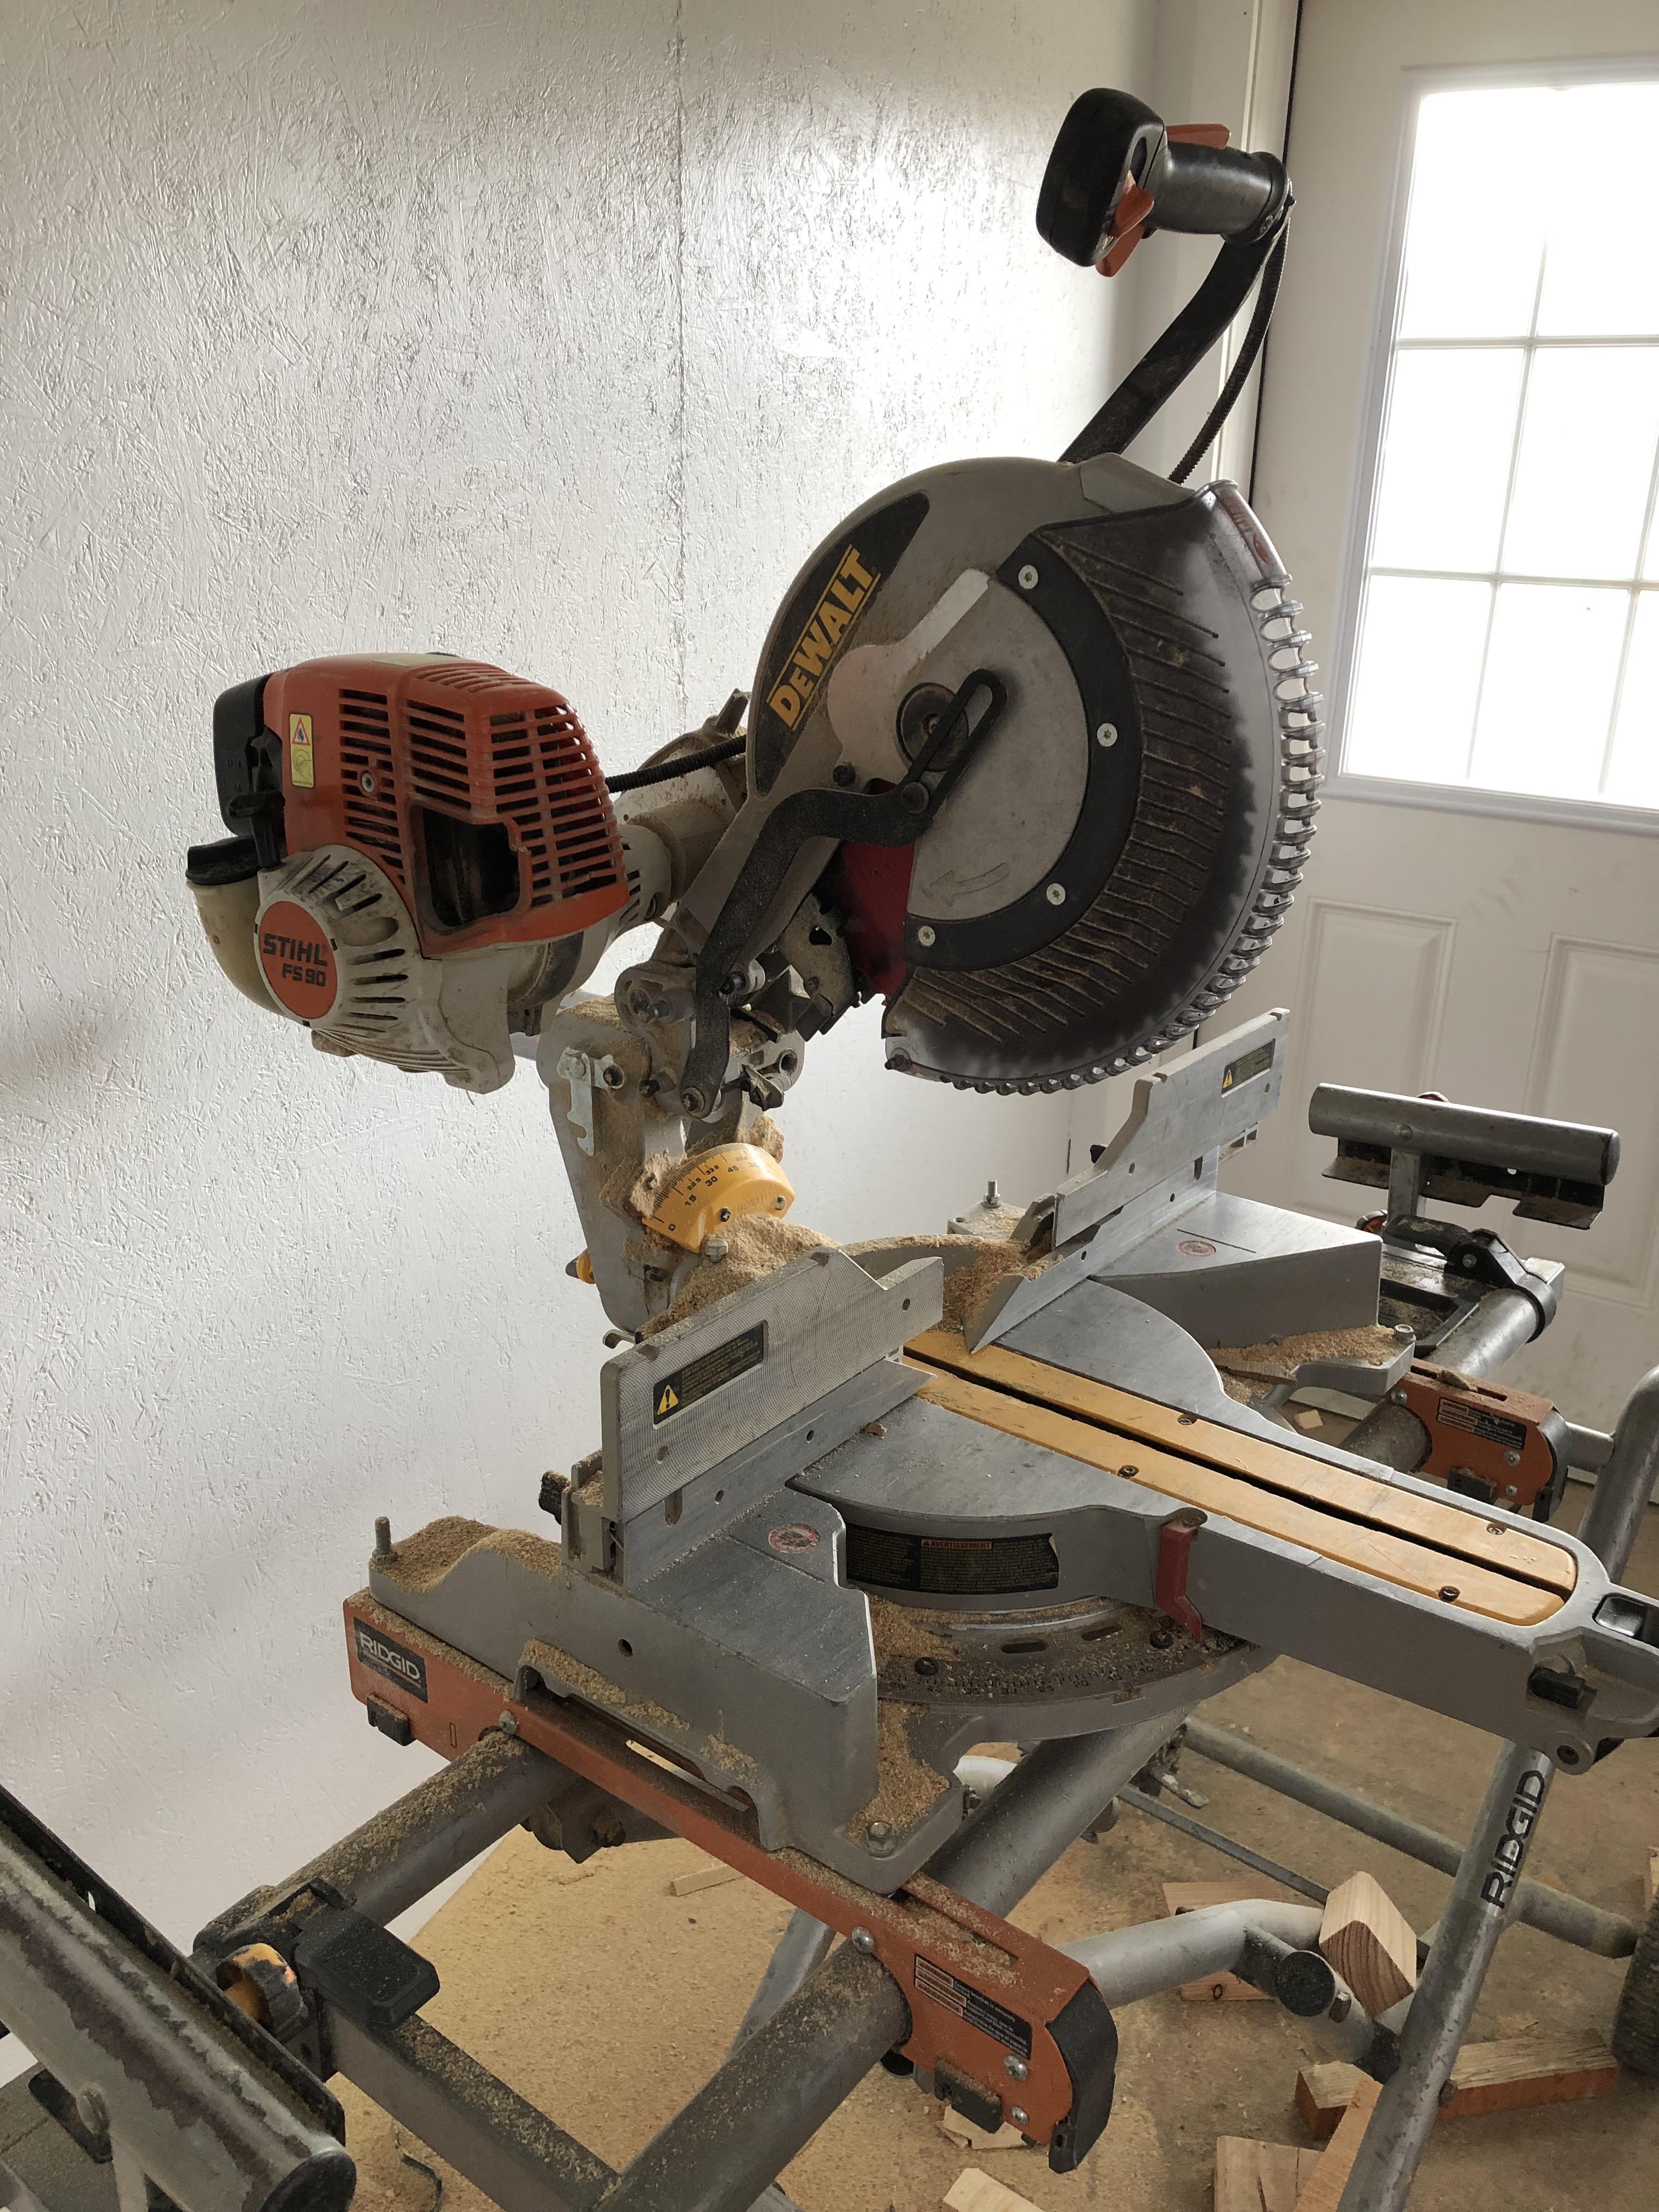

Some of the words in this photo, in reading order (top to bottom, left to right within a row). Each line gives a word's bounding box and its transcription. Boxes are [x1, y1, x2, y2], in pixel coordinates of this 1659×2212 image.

[769, 547, 874, 728] DEWALT
[263, 933, 328, 967] STIHL
[282, 962, 303, 981] FS
[305, 968, 326, 987] 90
[705, 1176, 718, 1187] 30
[685, 1194, 697, 1206] 15
[668, 1223, 676, 1232] 0
[930, 1540, 991, 1549] AVERTISSEMENT
[359, 1632, 421, 1680] RIDGID
[1073, 1679, 1089, 1688] 20
[1480, 1770, 1545, 1909] RIDGID
